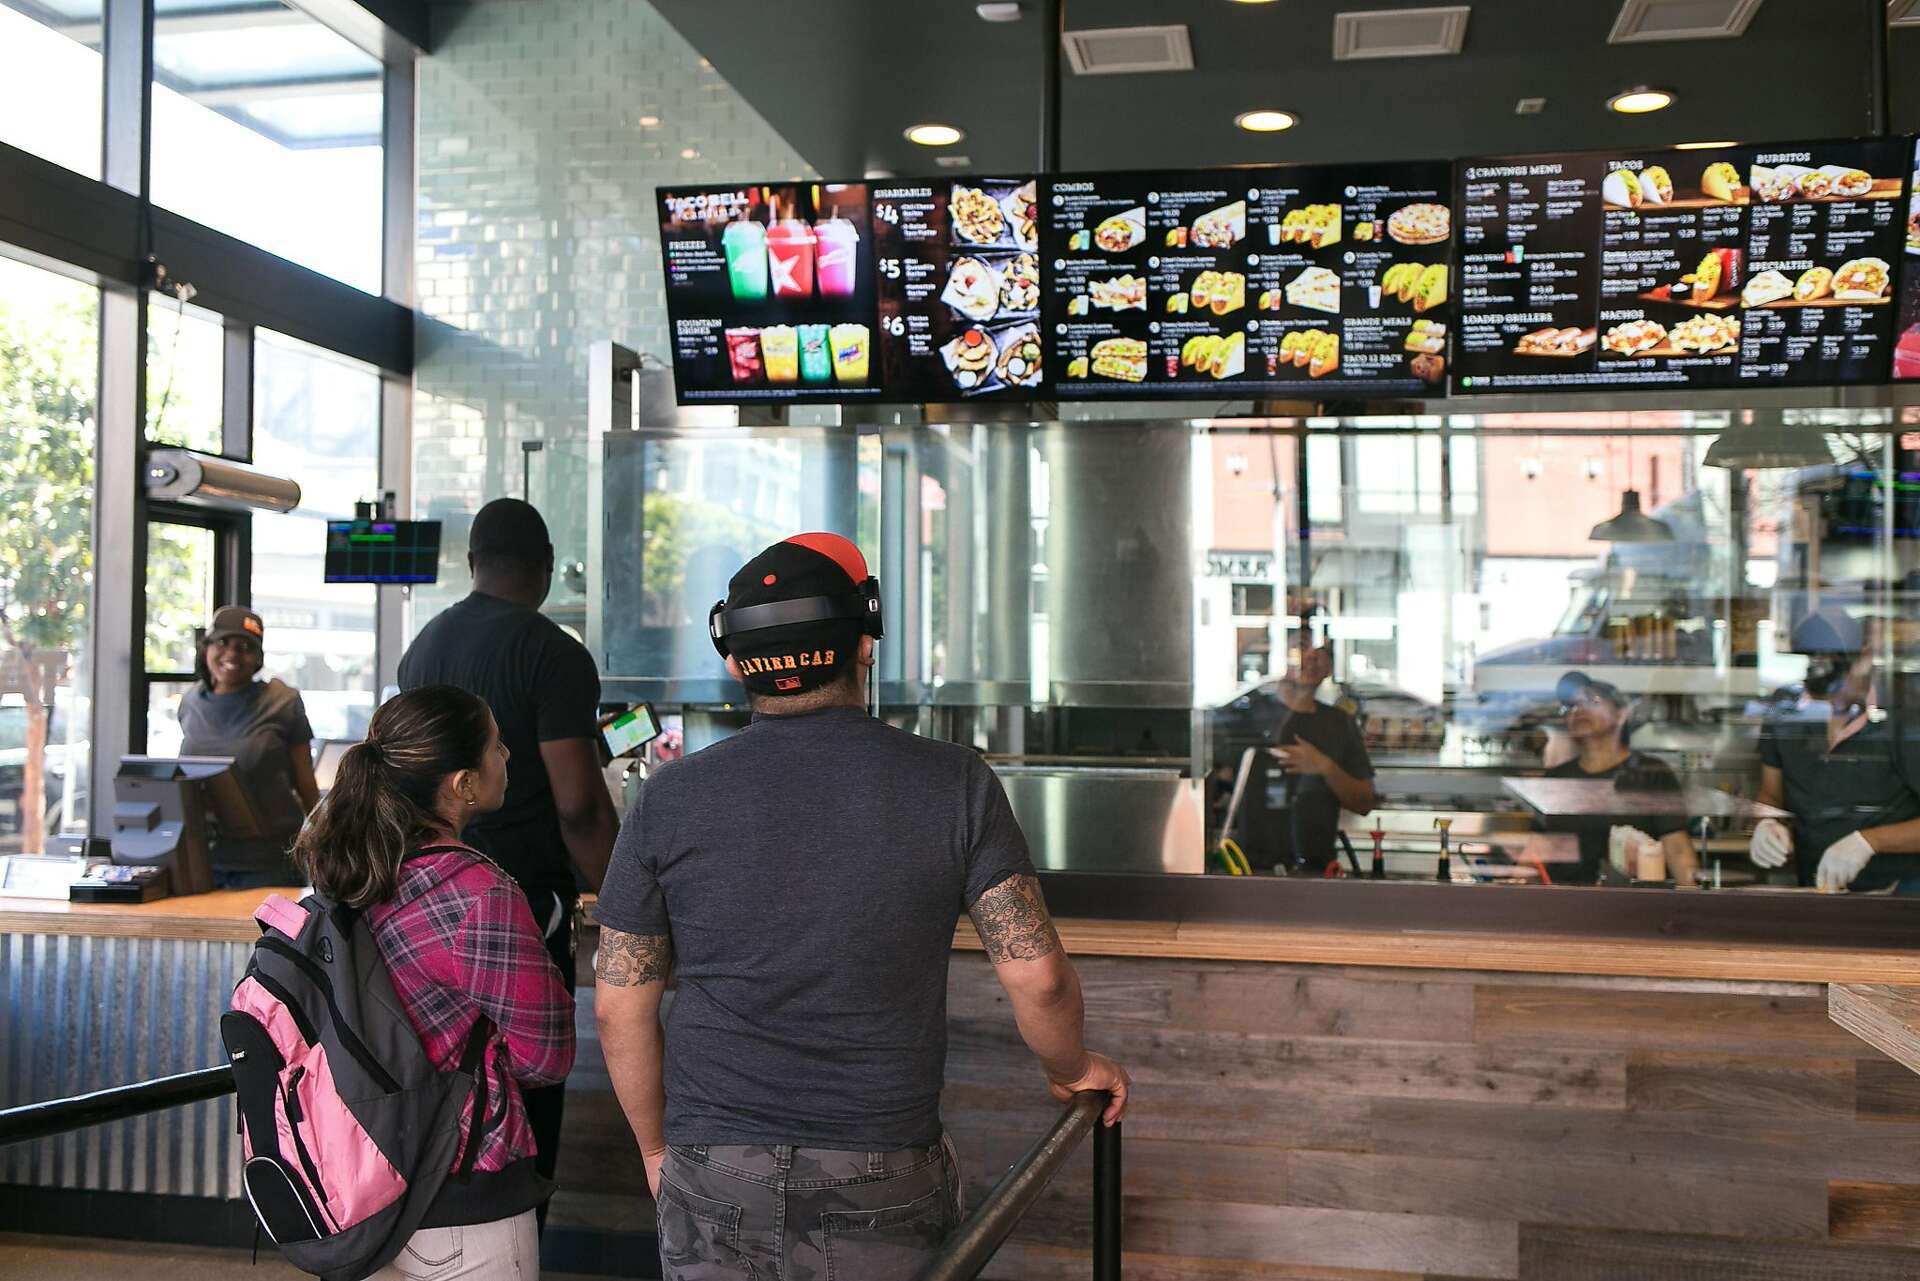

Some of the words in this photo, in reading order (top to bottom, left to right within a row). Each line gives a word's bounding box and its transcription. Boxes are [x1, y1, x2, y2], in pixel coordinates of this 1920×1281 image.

[1756, 152, 1811, 164] BURRITOS
[1476, 165, 1528, 178] CRAVINGS
[1530, 164, 1562, 176] MENU
[1609, 160, 1643, 171] TACOS
[1053, 183, 1094, 192] COMBOS
[876, 203, 899, 224] $4
[879, 258, 901, 279] $5
[1600, 309, 1645, 321] NACHOS
[882, 315, 905, 336] $6
